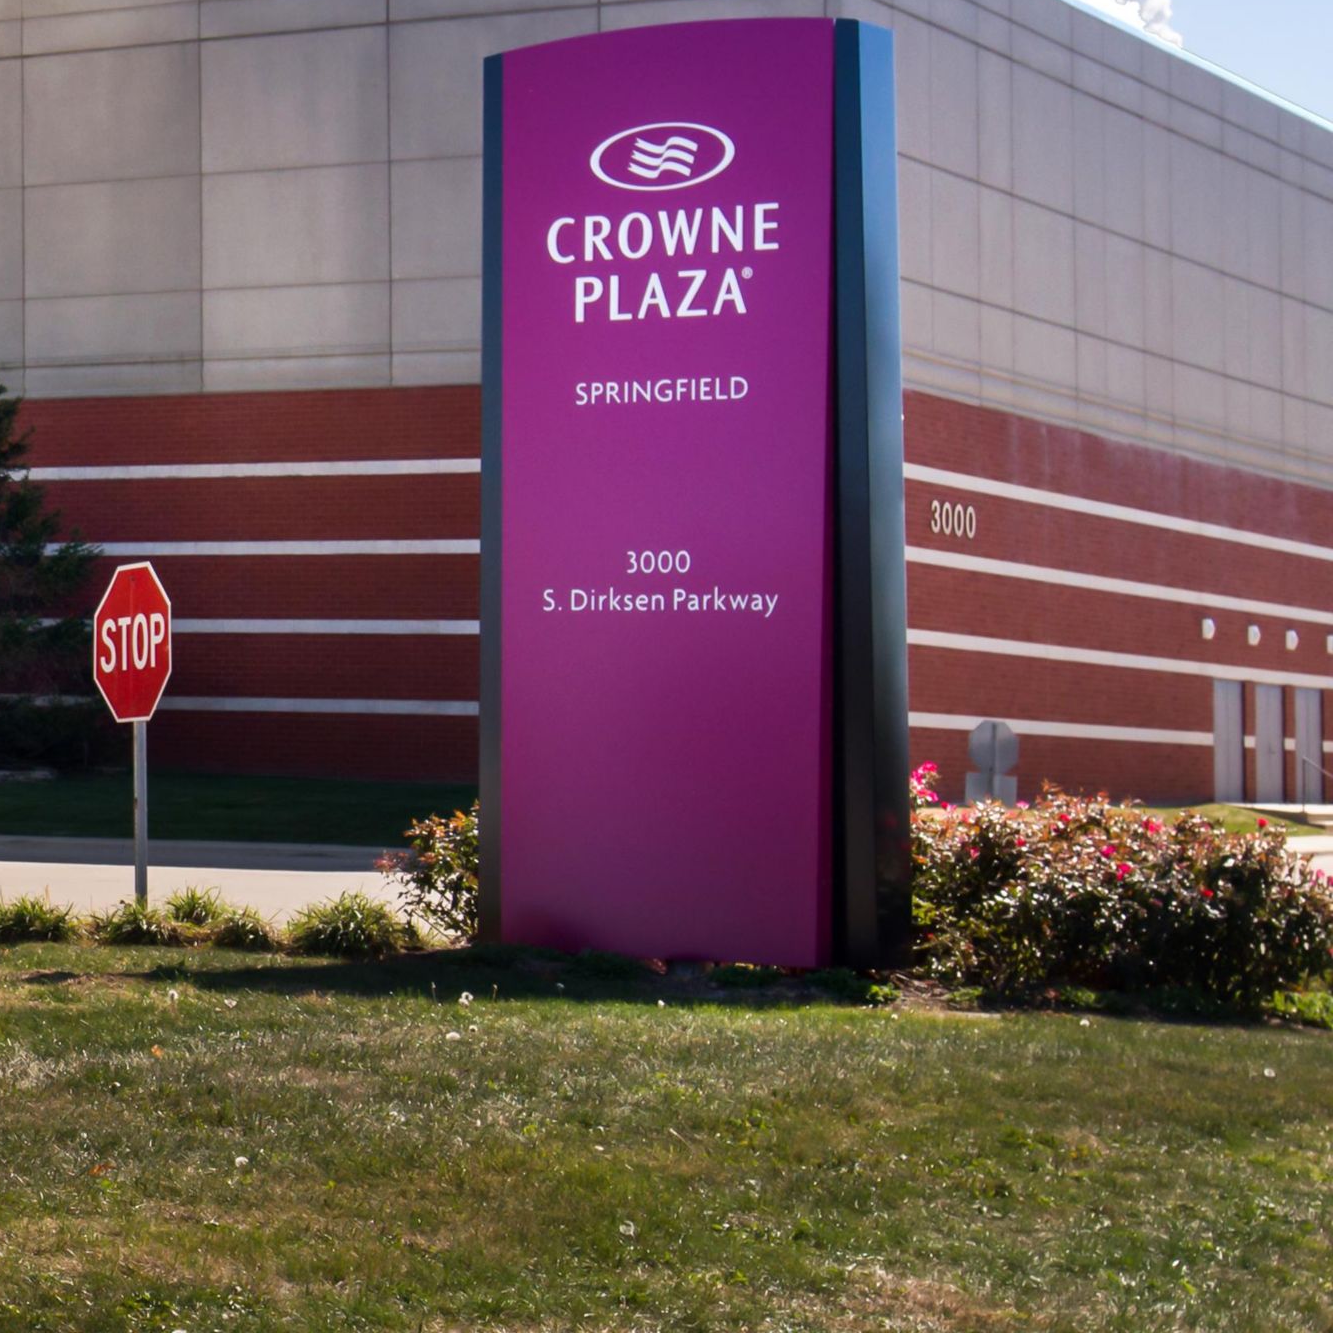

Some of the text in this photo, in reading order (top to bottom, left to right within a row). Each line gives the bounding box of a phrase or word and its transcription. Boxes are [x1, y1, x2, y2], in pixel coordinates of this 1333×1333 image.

[546, 202, 780, 264] CROWNE
[575, 376, 749, 406] SPRINGFIELD
[930, 499, 977, 540] 3000
[626, 549, 691, 574] 3000
[542, 586, 779, 618] S. Dirksen Parkway
[100, 612, 166, 674] STOP
